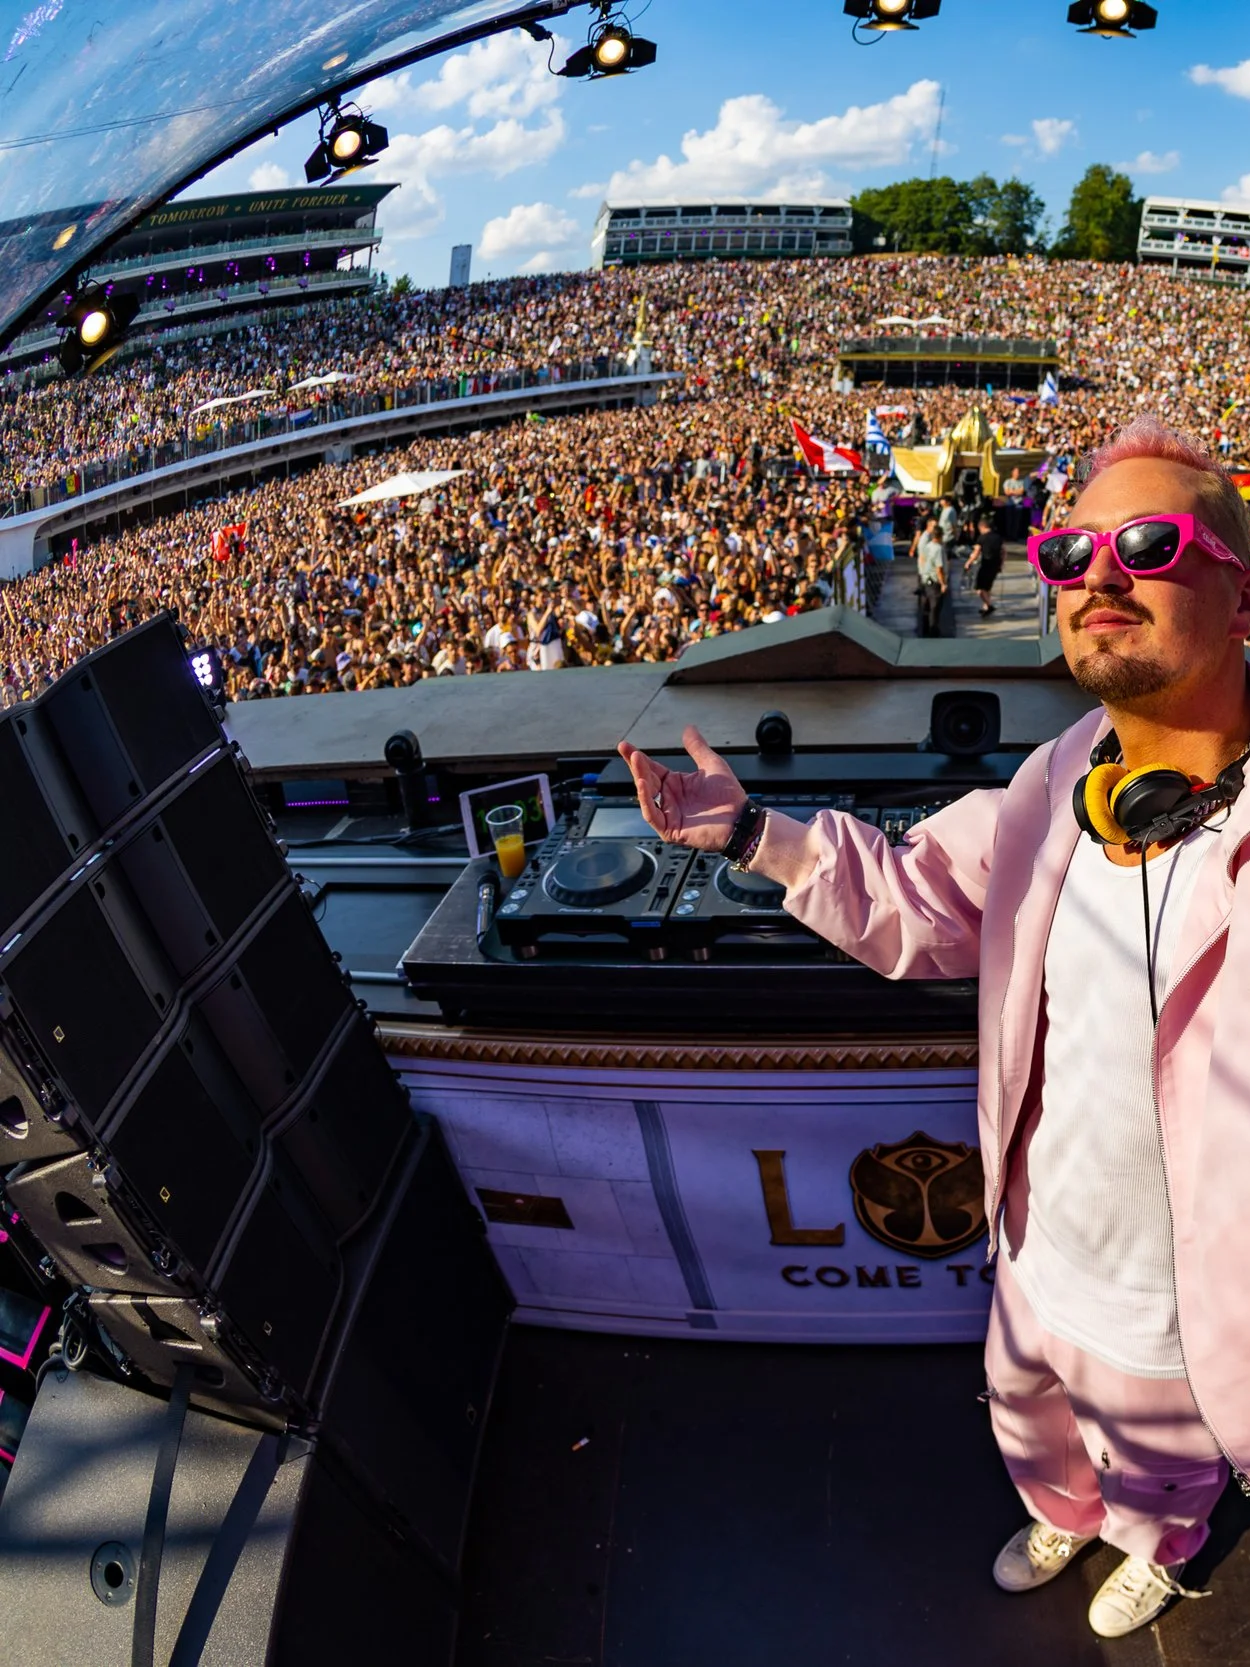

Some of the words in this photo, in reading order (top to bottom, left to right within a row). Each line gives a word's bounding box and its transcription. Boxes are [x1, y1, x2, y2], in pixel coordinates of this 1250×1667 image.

[150, 204, 229, 226] TOMORROW
[248, 198, 289, 213] UNITE
[291, 194, 348, 208] FOREVER
[781, 1265, 922, 1288] COME
